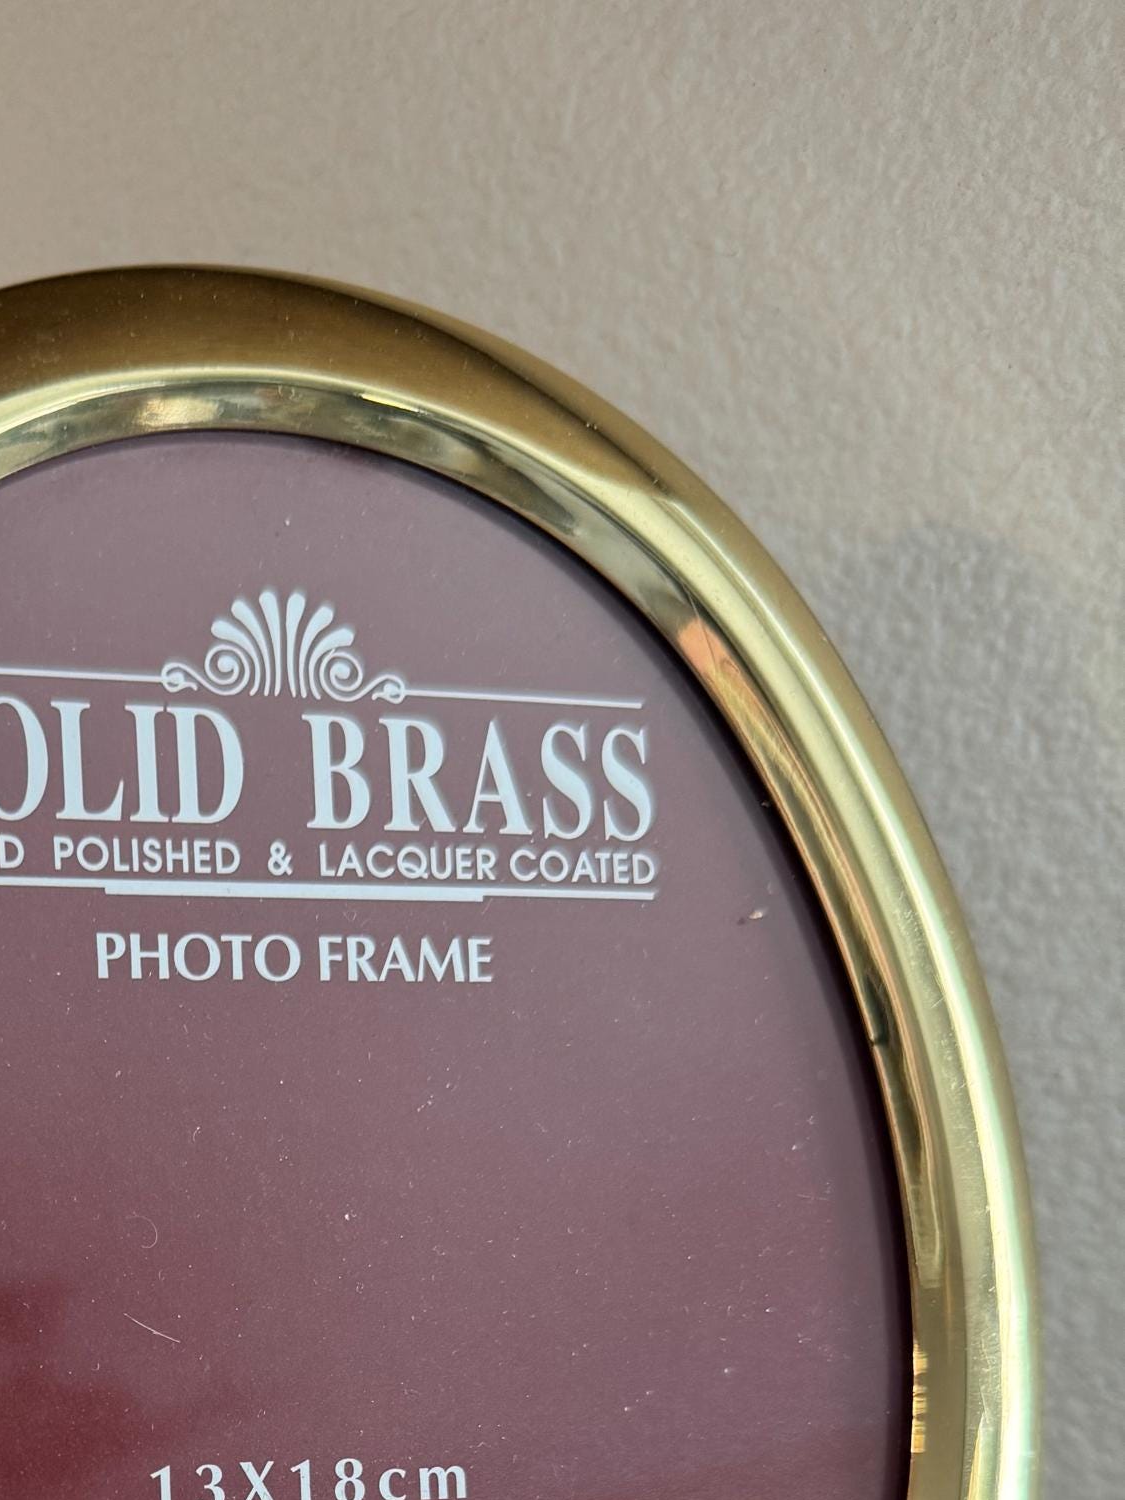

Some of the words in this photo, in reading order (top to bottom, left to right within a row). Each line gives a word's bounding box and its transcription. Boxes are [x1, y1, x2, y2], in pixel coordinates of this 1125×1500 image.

[302, 713, 653, 841] BRASS
[53, 836, 241, 874] POLISHED
[267, 841, 293, 876] &
[319, 842, 497, 880] LACQUER
[509, 848, 656, 885] COATED
[96, 932, 301, 982] PHOTO
[317, 935, 493, 983] FRAME
